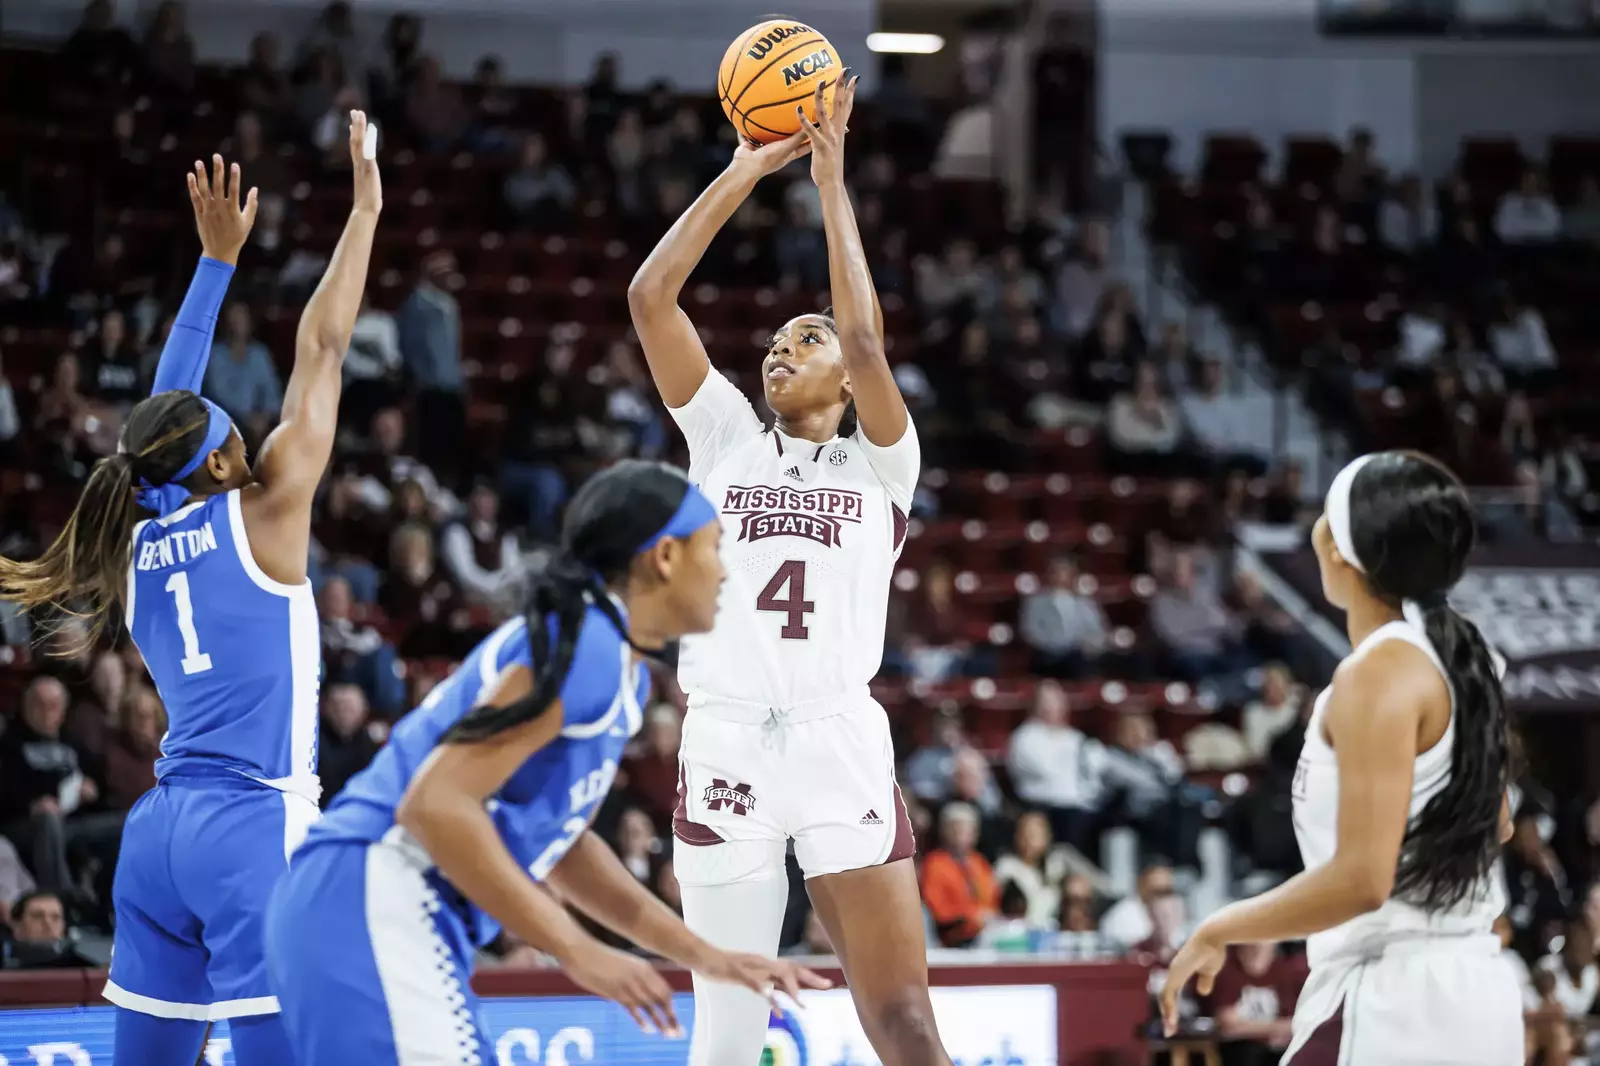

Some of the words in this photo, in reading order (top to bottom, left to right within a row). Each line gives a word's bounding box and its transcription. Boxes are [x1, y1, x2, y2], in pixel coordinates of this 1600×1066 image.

[782, 49, 833, 86] NCAA
[829, 450, 847, 465] SEC
[723, 489, 863, 519] MISSISSIPPI
[756, 516, 825, 540] STATE
[136, 521, 218, 571] BENTON
[756, 559, 815, 640] 4
[165, 571, 213, 675] 1
[712, 789, 747, 804] STATE
